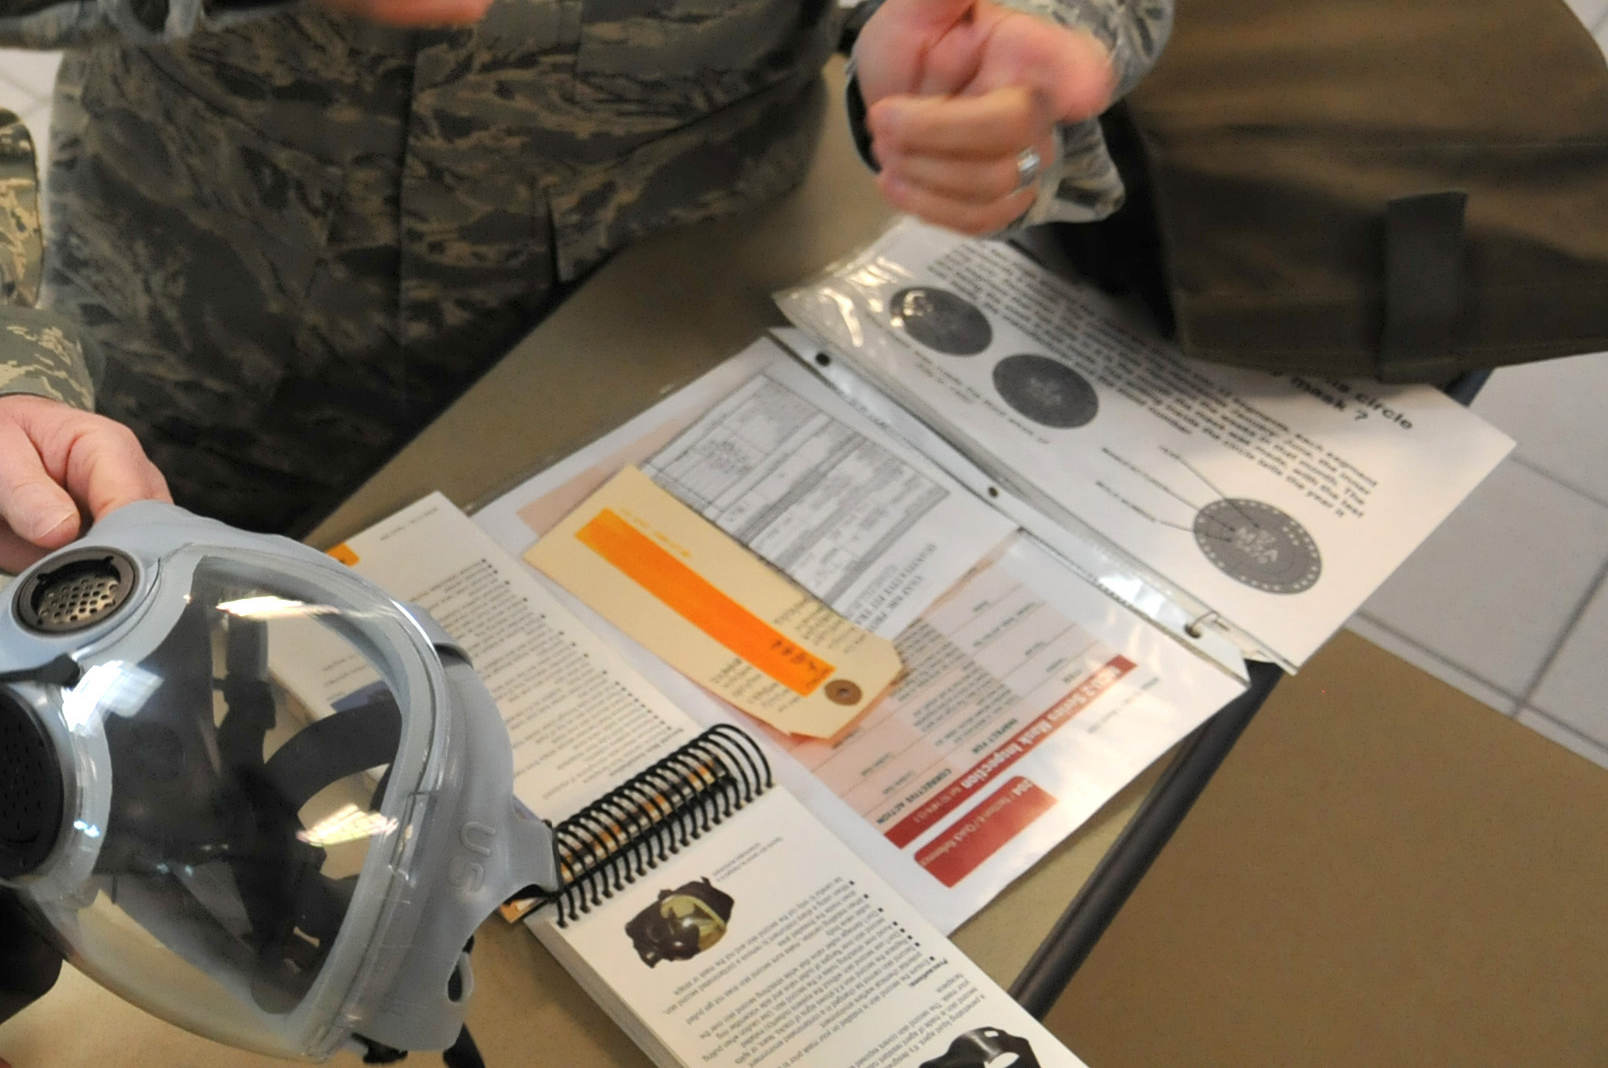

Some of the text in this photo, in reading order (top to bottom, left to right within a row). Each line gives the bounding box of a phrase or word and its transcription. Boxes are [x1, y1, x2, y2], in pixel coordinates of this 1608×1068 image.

[1354, 392, 1414, 431] circle
[1046, 691, 1087, 726] Series
[986, 717, 1018, 743] INSPECT
[1017, 718, 1052, 748] Mask
[960, 746, 1022, 791] Inspection
[876, 767, 952, 826] CORRECTIVE ACTION
[448, 820, 496, 893] US
